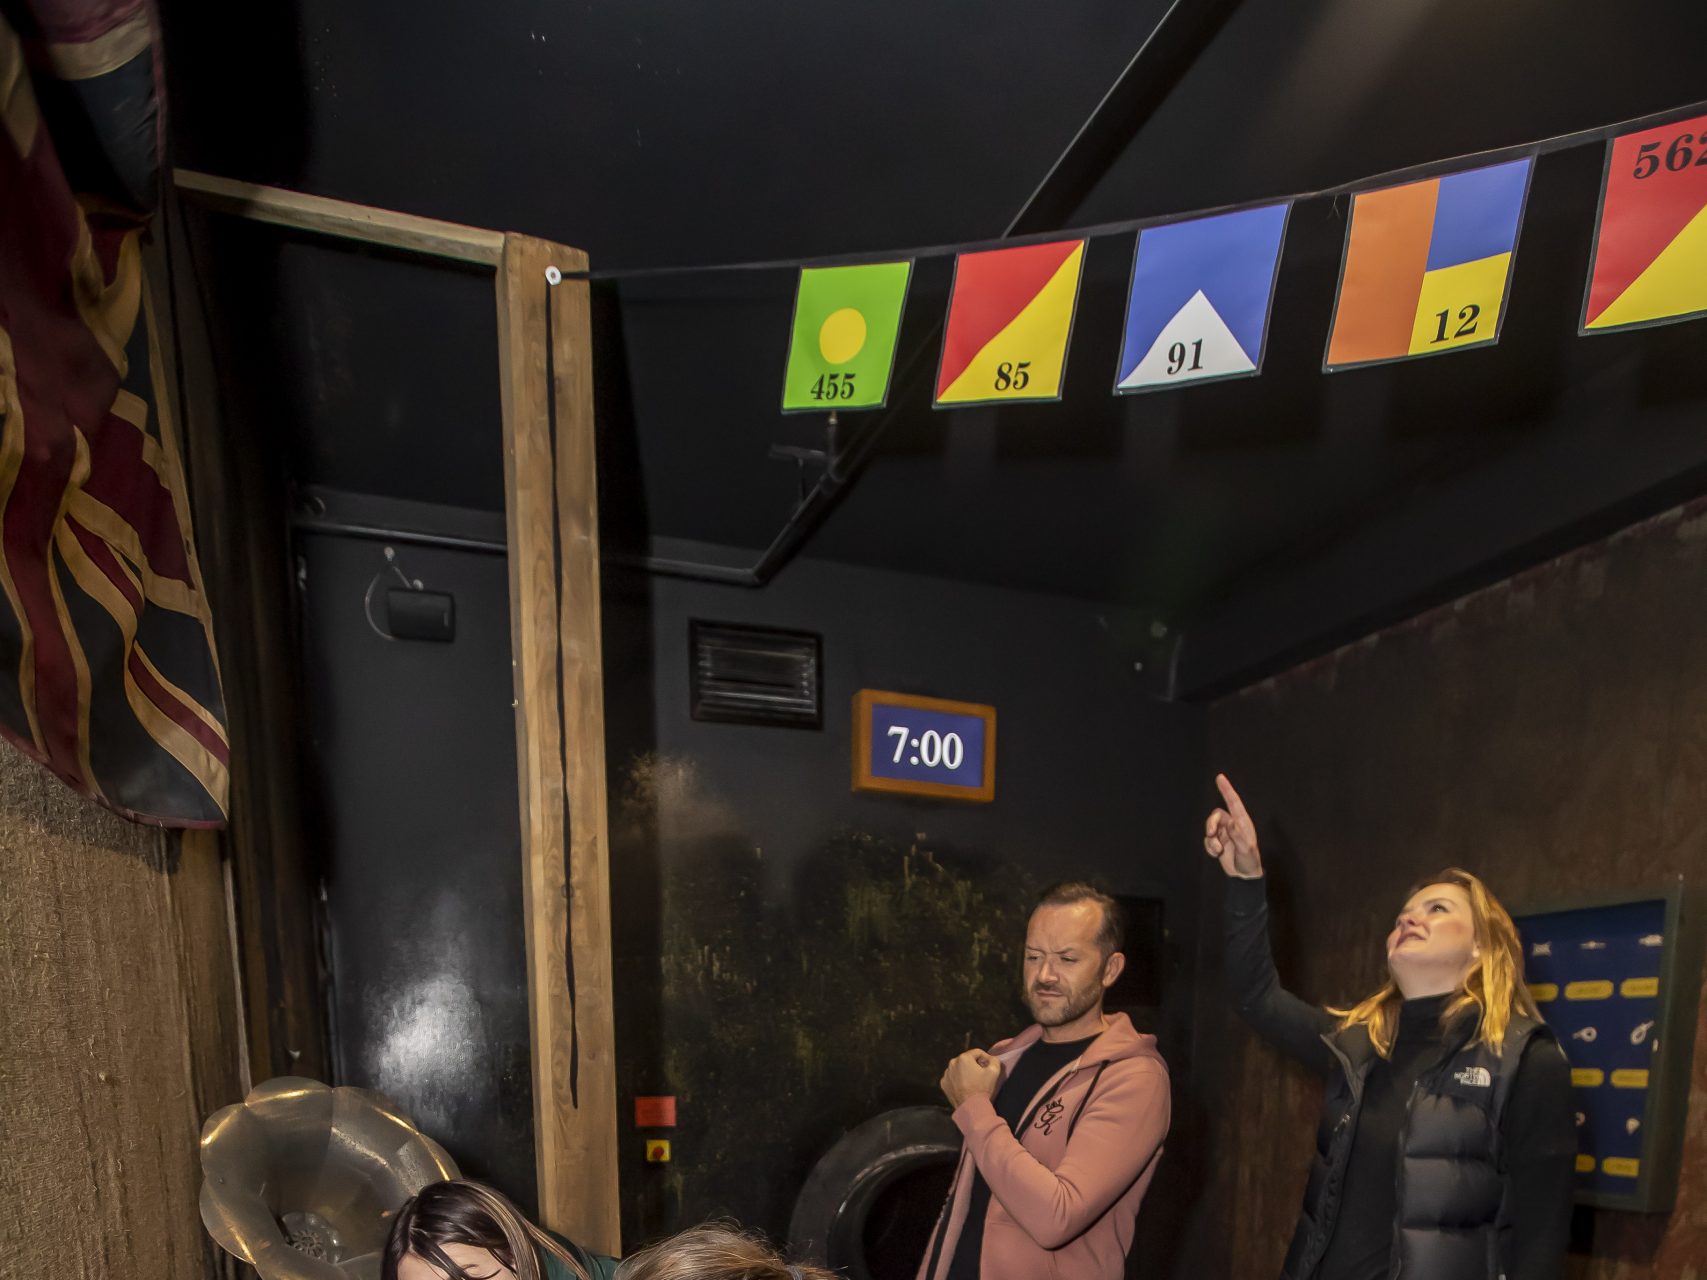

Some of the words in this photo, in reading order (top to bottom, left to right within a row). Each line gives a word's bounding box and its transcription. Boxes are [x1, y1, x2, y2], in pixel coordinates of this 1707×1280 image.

[1430, 304, 1481, 344] 12
[1167, 338, 1203, 375] 91
[810, 373, 856, 400] 455
[994, 361, 1031, 391] 85
[887, 725, 964, 770] 7:00
